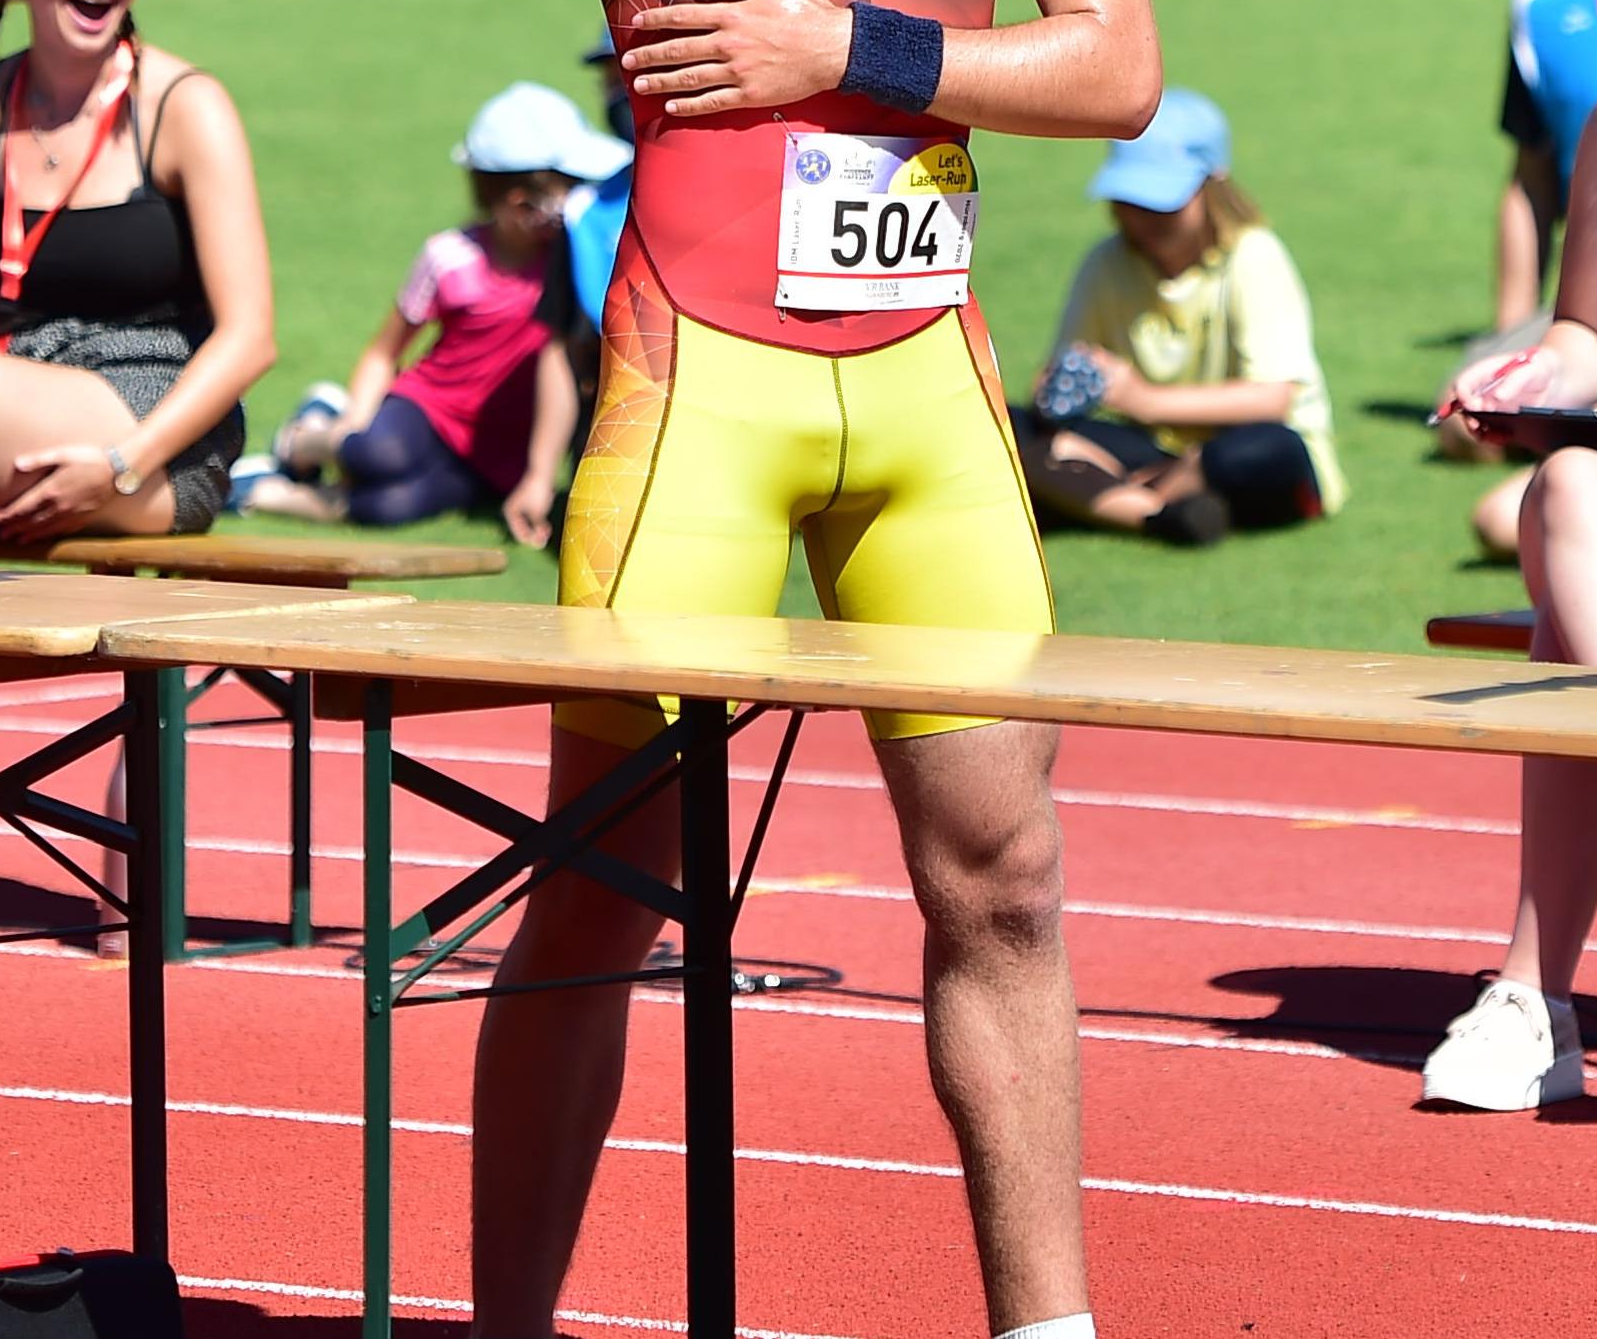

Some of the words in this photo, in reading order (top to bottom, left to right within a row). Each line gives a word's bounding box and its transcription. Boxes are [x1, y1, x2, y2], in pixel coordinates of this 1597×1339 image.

[938, 154, 963, 169] Let's
[910, 173, 967, 187] Laser-Run
[831, 200, 940, 268] 504
